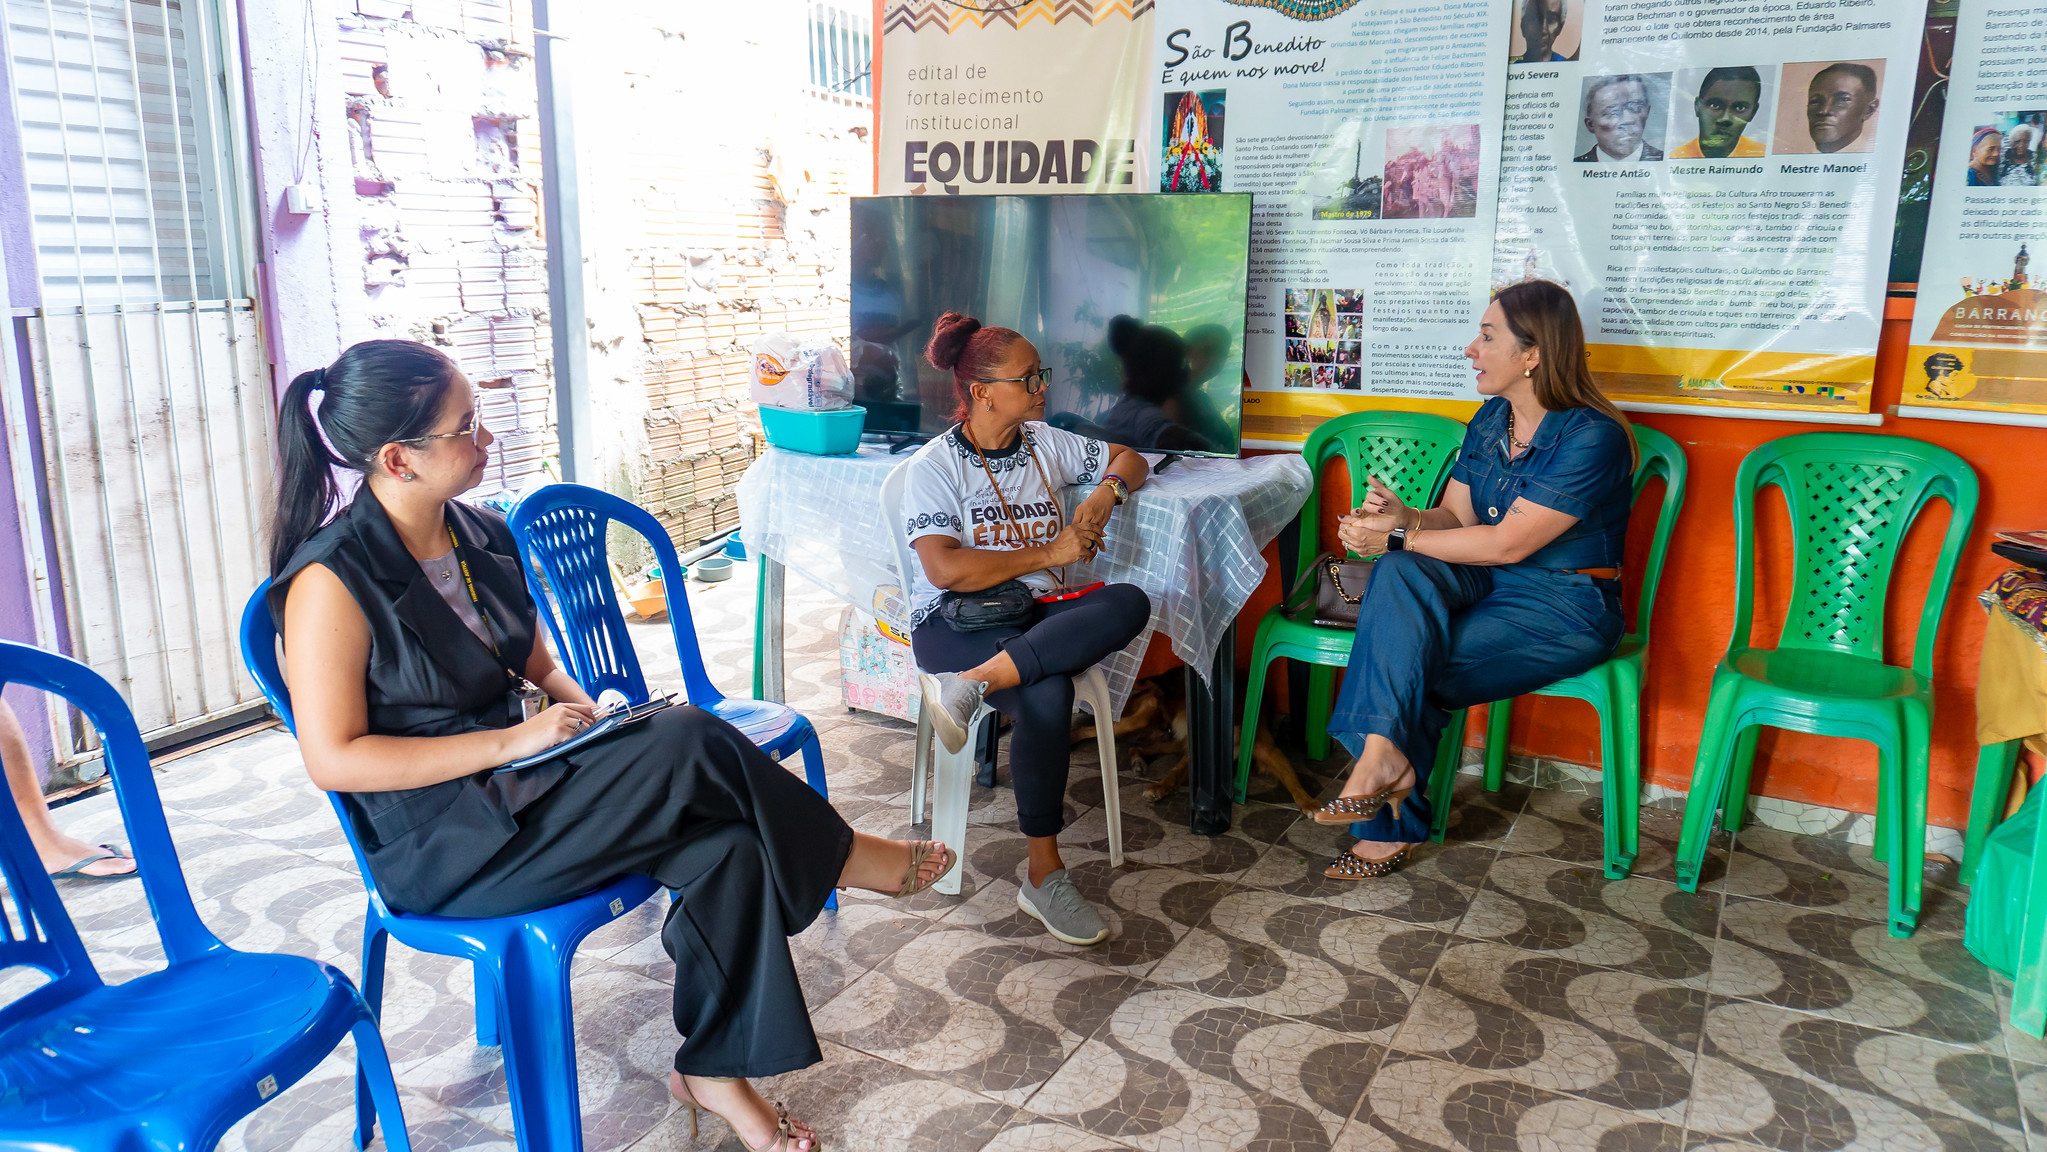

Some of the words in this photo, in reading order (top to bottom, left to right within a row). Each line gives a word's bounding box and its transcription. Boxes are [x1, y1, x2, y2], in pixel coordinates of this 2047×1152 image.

[1604, 3, 1628, 11] foram
[1630, 0, 1673, 11] chegando
[1604, 13, 1634, 23] Maroca
[1637, 10, 1677, 20] Bechman
[1695, 6, 1746, 18] governador
[1749, 4, 1760, 13] da
[1762, 3, 1792, 14] época,
[1796, 0, 1836, 10] Eduardo
[1602, 26, 1618, 35] que
[1620, 23, 1641, 32] doou
[1674, 22, 1690, 30] que
[1692, 19, 1721, 28] obtera
[1723, 14, 1796, 26] reconhecimento
[1799, 12, 1810, 22] de
[1813, 11, 1834, 21] área
[1985, 21, 2028, 29] Barranco
[2031, 19, 2043, 27] de
[1658, 32, 1669, 41] de
[1671, 29, 1712, 40] Quilombo
[1715, 28, 1742, 38] desde
[1746, 26, 1770, 36] 2014,
[1773, 25, 1792, 36] pela
[1796, 22, 1842, 34] Fundação
[1846, 20, 1891, 31] Palmares
[2030, 32, 2042, 40] da
[1164, 28, 1215, 68] São
[1223, 20, 1326, 61] Benedito
[908, 64, 958, 81] edital
[966, 64, 986, 79] de
[1180, 67, 1230, 86] quem
[1236, 67, 1268, 78] nos
[1274, 58, 1326, 75] move!
[1508, 72, 1525, 80] ovó
[1528, 71, 1559, 79] Severa
[907, 88, 1044, 106] fortalecimento
[1974, 94, 2008, 102] natural
[905, 114, 1019, 131] institucional
[905, 140, 1134, 194] EQUIDADE
[1582, 170, 1618, 178] Mestre
[1620, 168, 1650, 178] Antão
[1670, 166, 1706, 174] Mestre
[1709, 164, 1763, 174] Raimundo
[1780, 164, 1820, 174] Mestre
[1823, 163, 1866, 173] Manoel
[1321, 210, 1344, 218] Mastro
[1955, 307, 2047, 321] BARRANC
